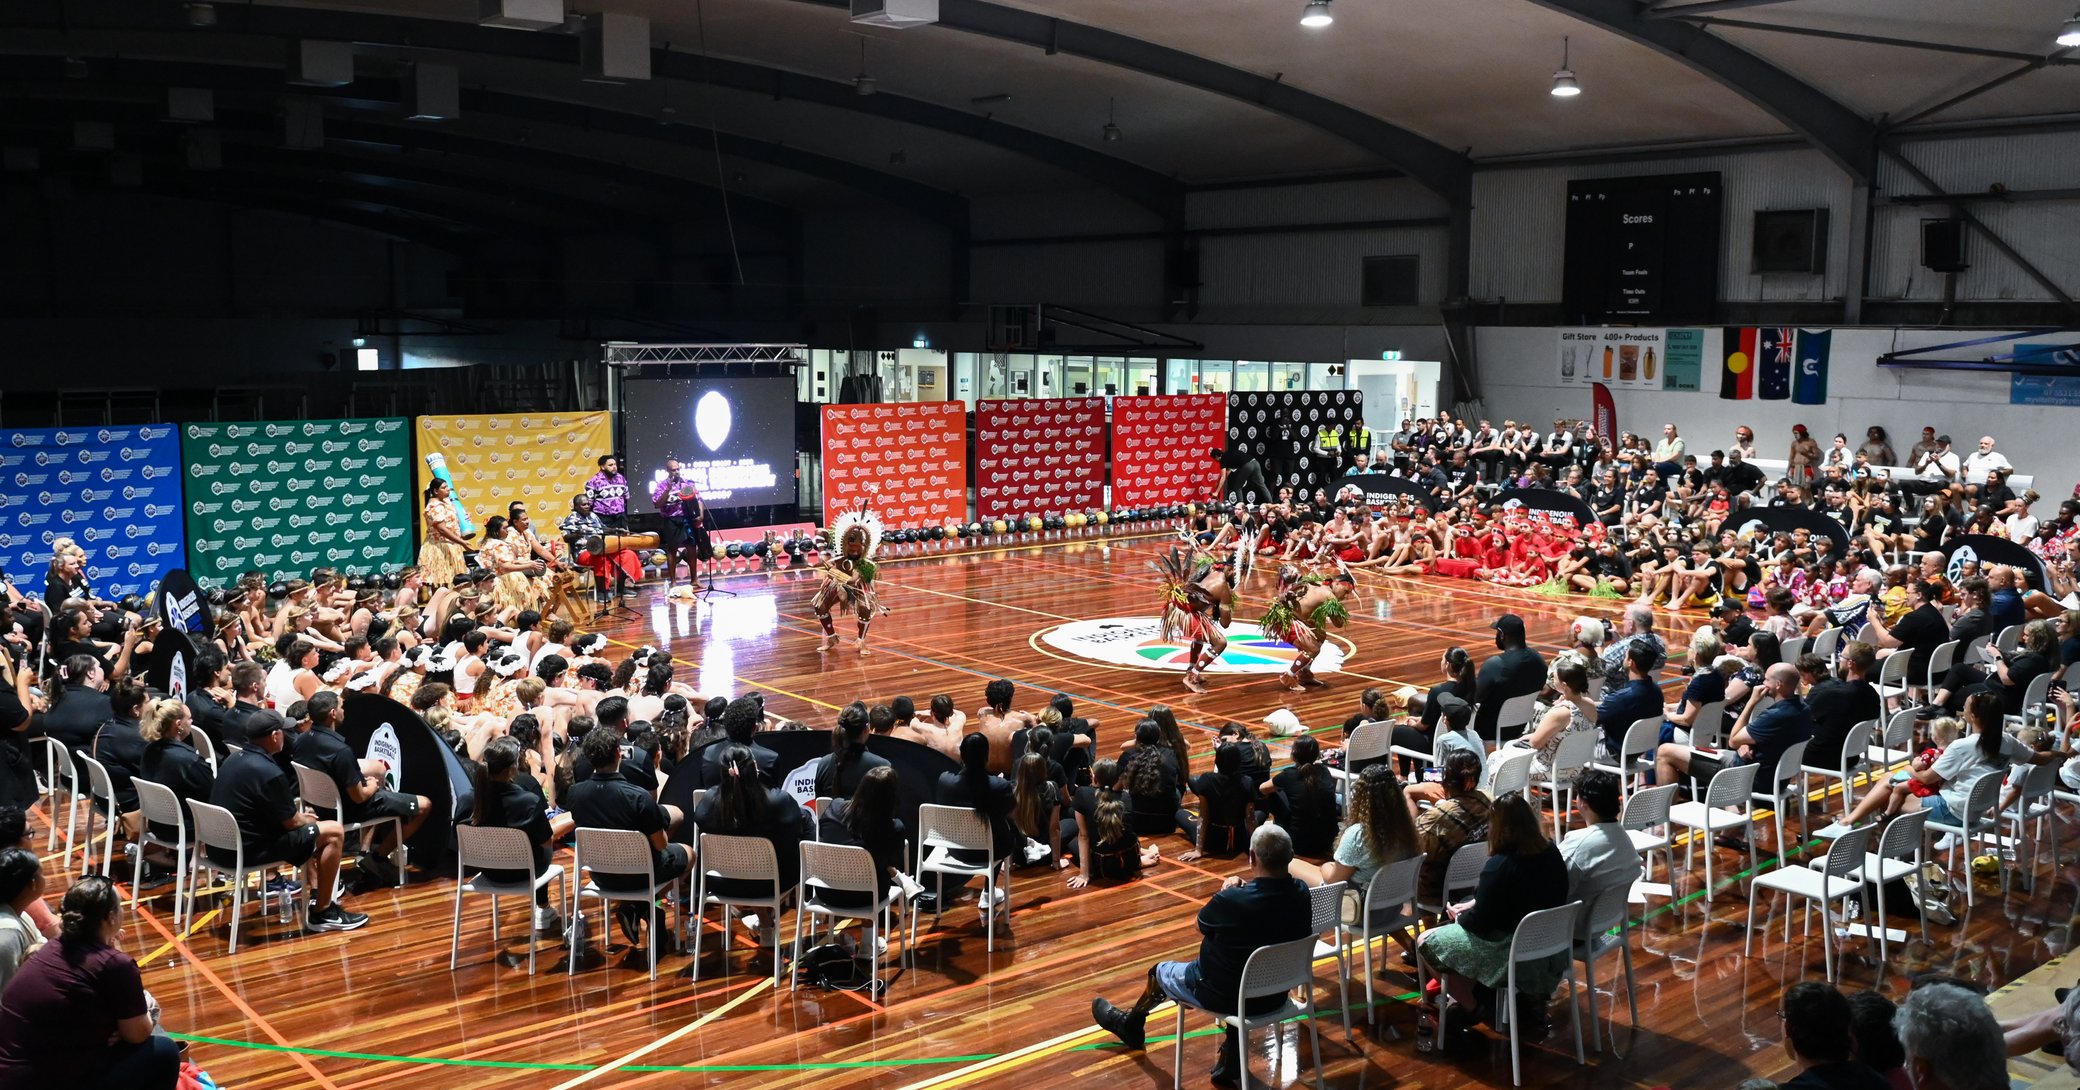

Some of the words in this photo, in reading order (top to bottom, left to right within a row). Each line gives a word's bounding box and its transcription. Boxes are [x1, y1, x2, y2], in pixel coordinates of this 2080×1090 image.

[1623, 214, 1653, 224] Scores
[1563, 333, 1575, 341] Gift
[1577, 333, 1597, 341] Store
[1604, 333, 1623, 341] 400+
[1625, 333, 1659, 341] Products
[1366, 492, 1414, 501] INDIGENS
[1528, 509, 1574, 518] INDENOUS
